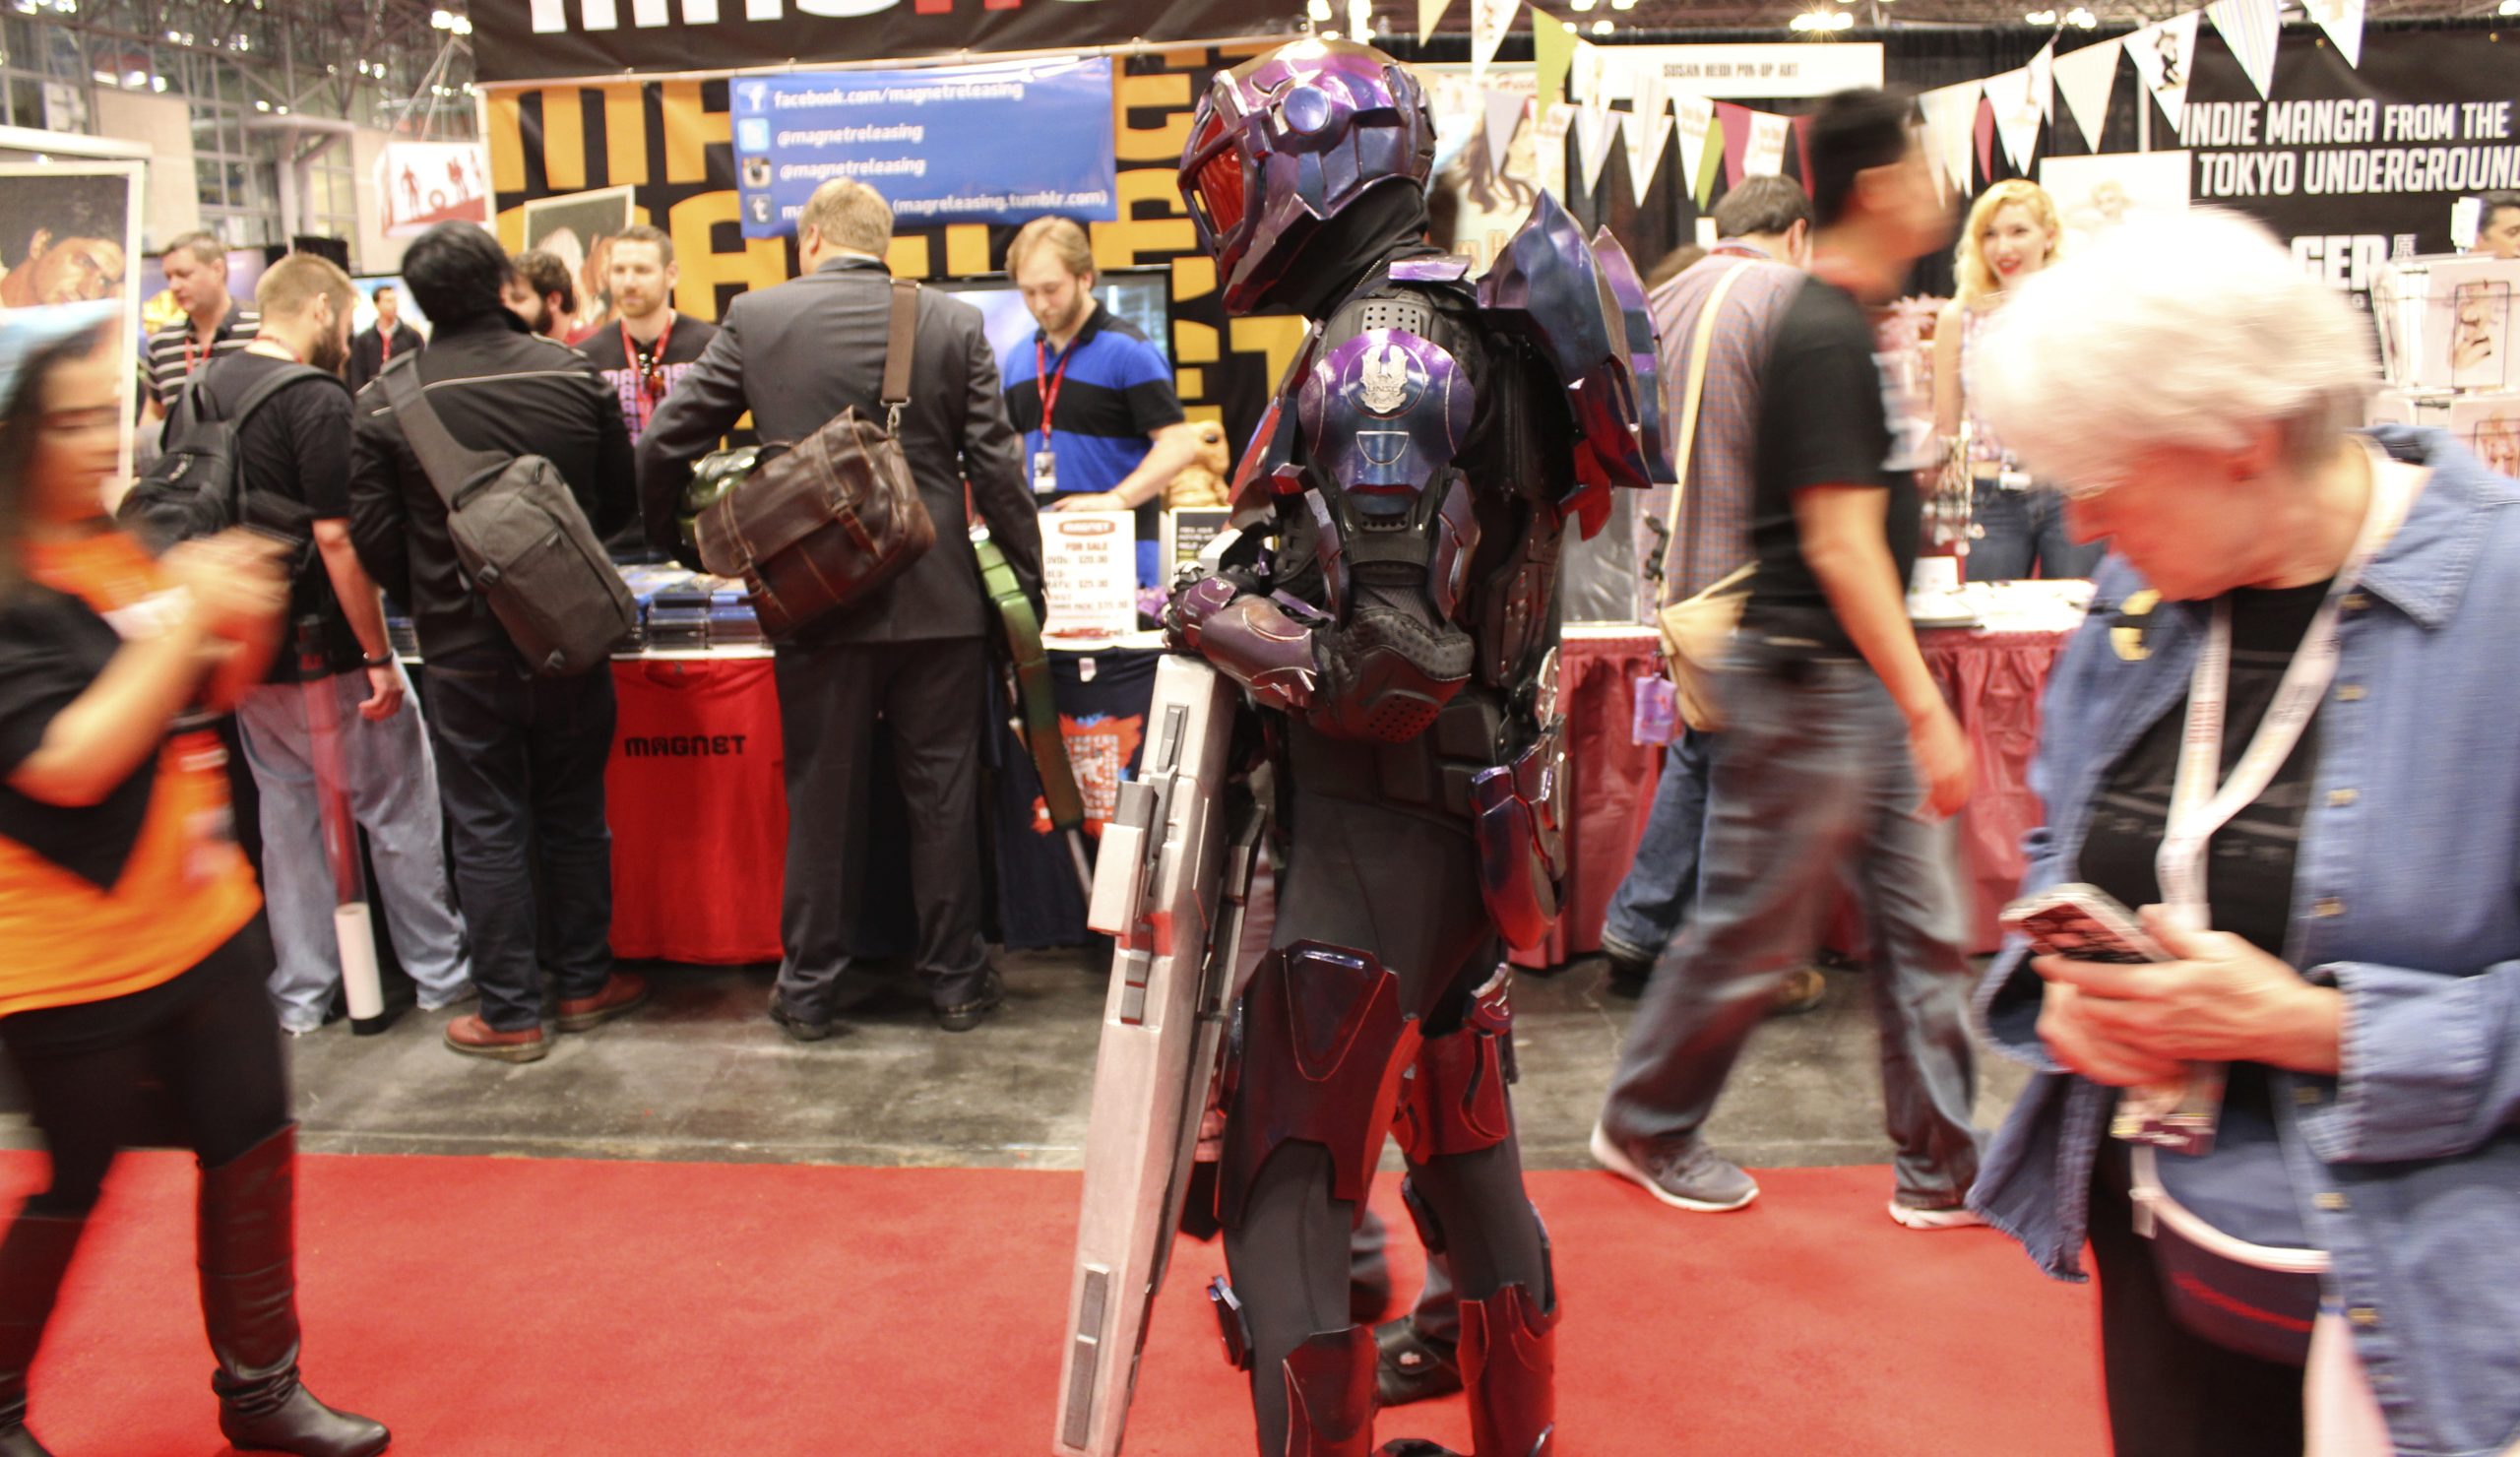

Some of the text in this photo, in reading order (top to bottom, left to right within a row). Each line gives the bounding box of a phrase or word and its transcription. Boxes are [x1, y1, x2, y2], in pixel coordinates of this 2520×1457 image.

[774, 83, 1025, 109] facebook.com/magnetreleasing
[778, 123, 924, 147] @magnetreleasing
[2179, 98, 2510, 147] INDIE MANGA FROM THE
[780, 157, 926, 180] @magnetreleasing
[2198, 152, 2297, 197] TOKYO
[892, 190, 1108, 216] (magreleasing.tumblr.com)
[1087, 541, 1108, 551] SALE
[624, 734, 746, 756] MAGNET
